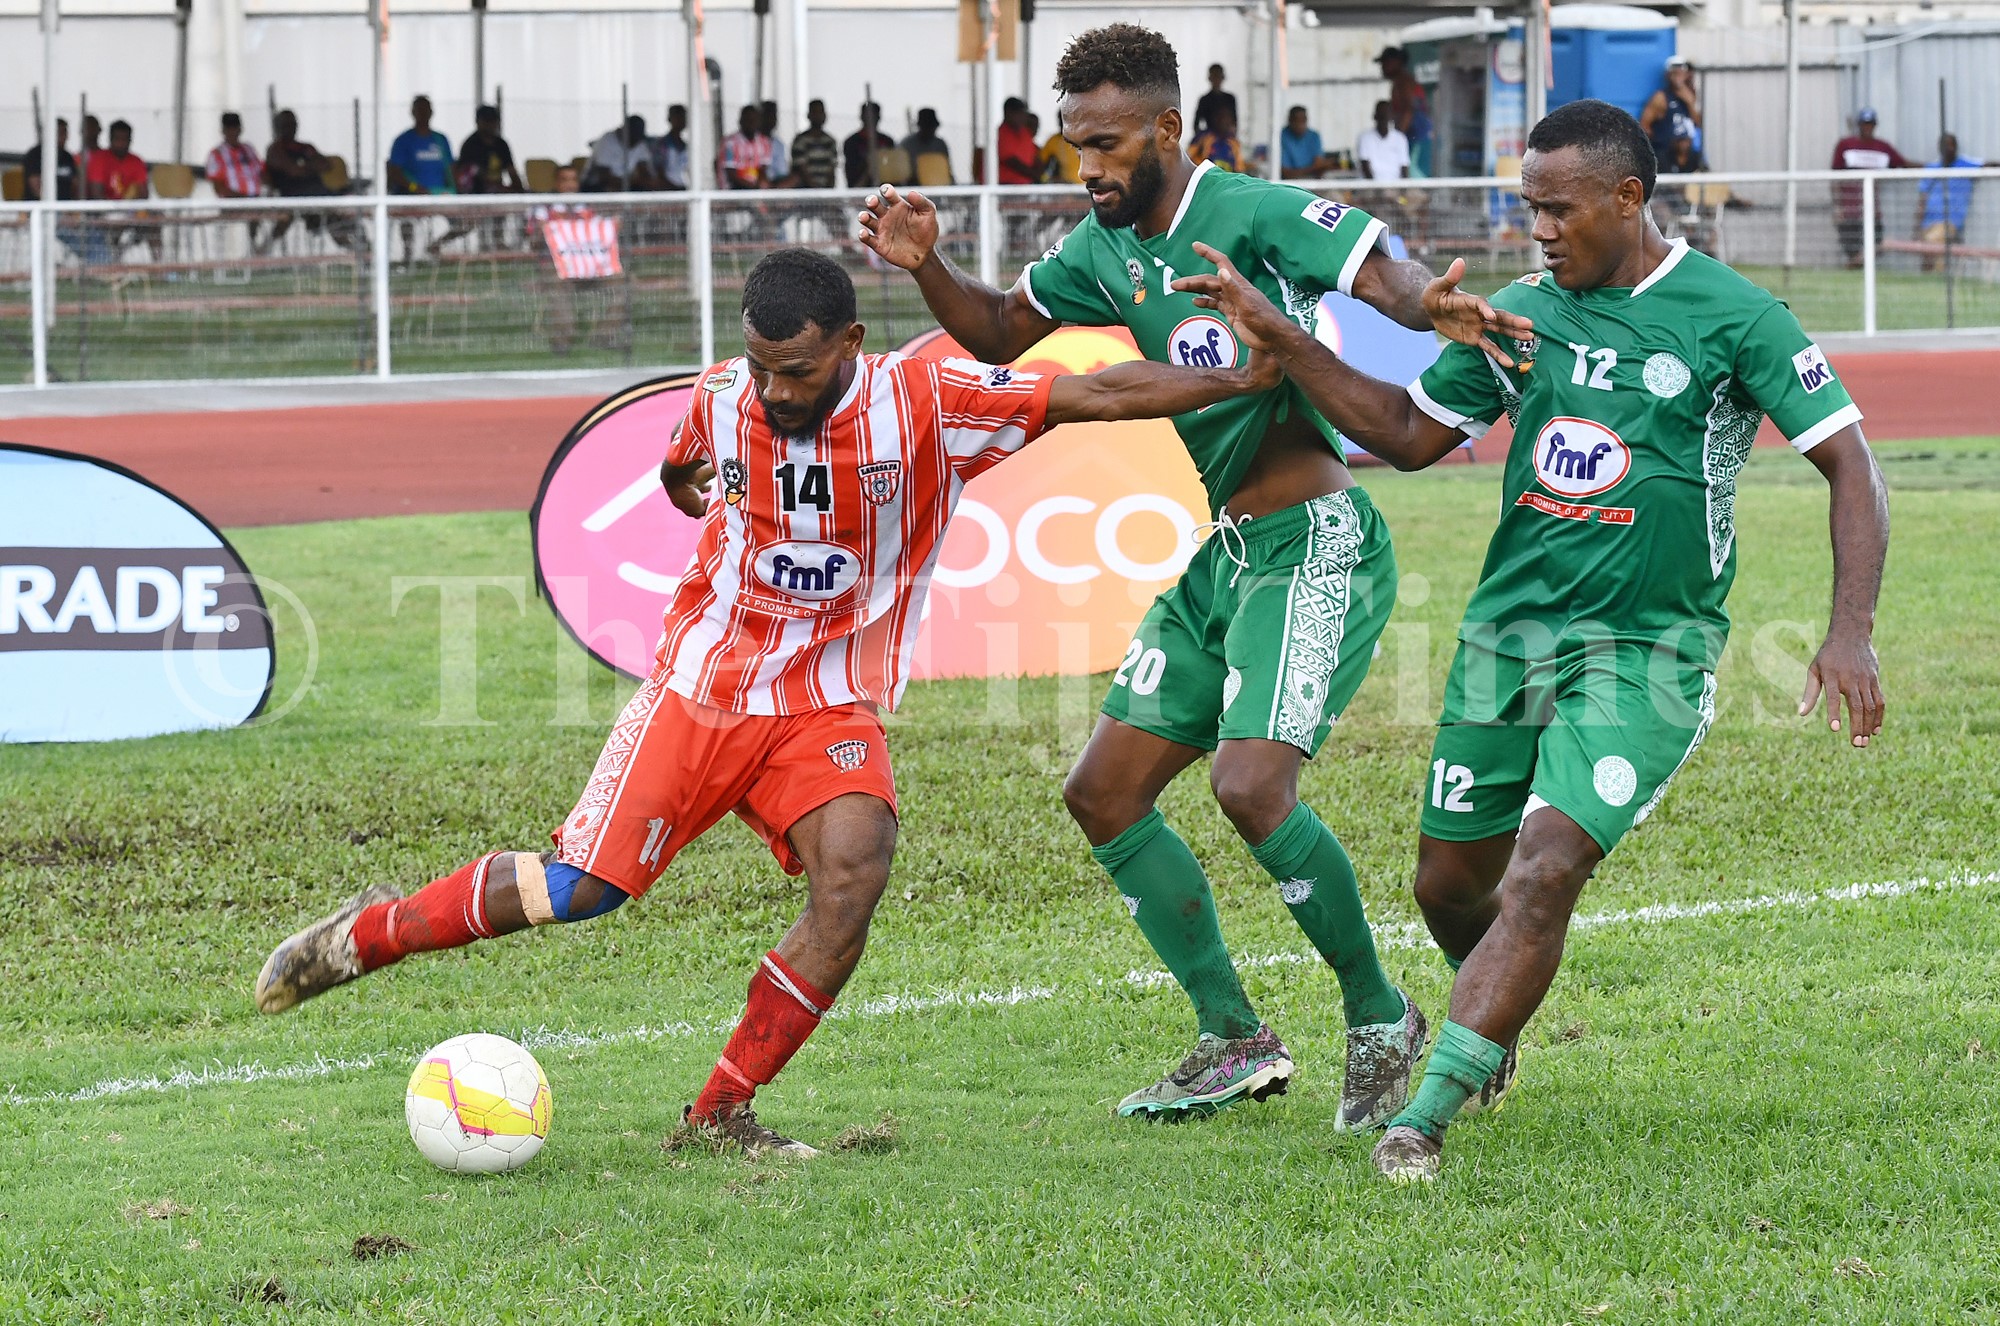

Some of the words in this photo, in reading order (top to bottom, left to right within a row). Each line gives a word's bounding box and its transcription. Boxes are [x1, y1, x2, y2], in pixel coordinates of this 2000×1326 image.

[1178, 328, 1223, 368] fmf
[1568, 341, 1618, 391] 12
[1543, 431, 1612, 481] fmf
[775, 463, 832, 512] 14
[1564, 507, 1578, 516] OF
[771, 553, 848, 591] fmf
[753, 600, 800, 616] PROMISE
[1113, 638, 1167, 695] 20
[1431, 757, 1475, 812] 12
